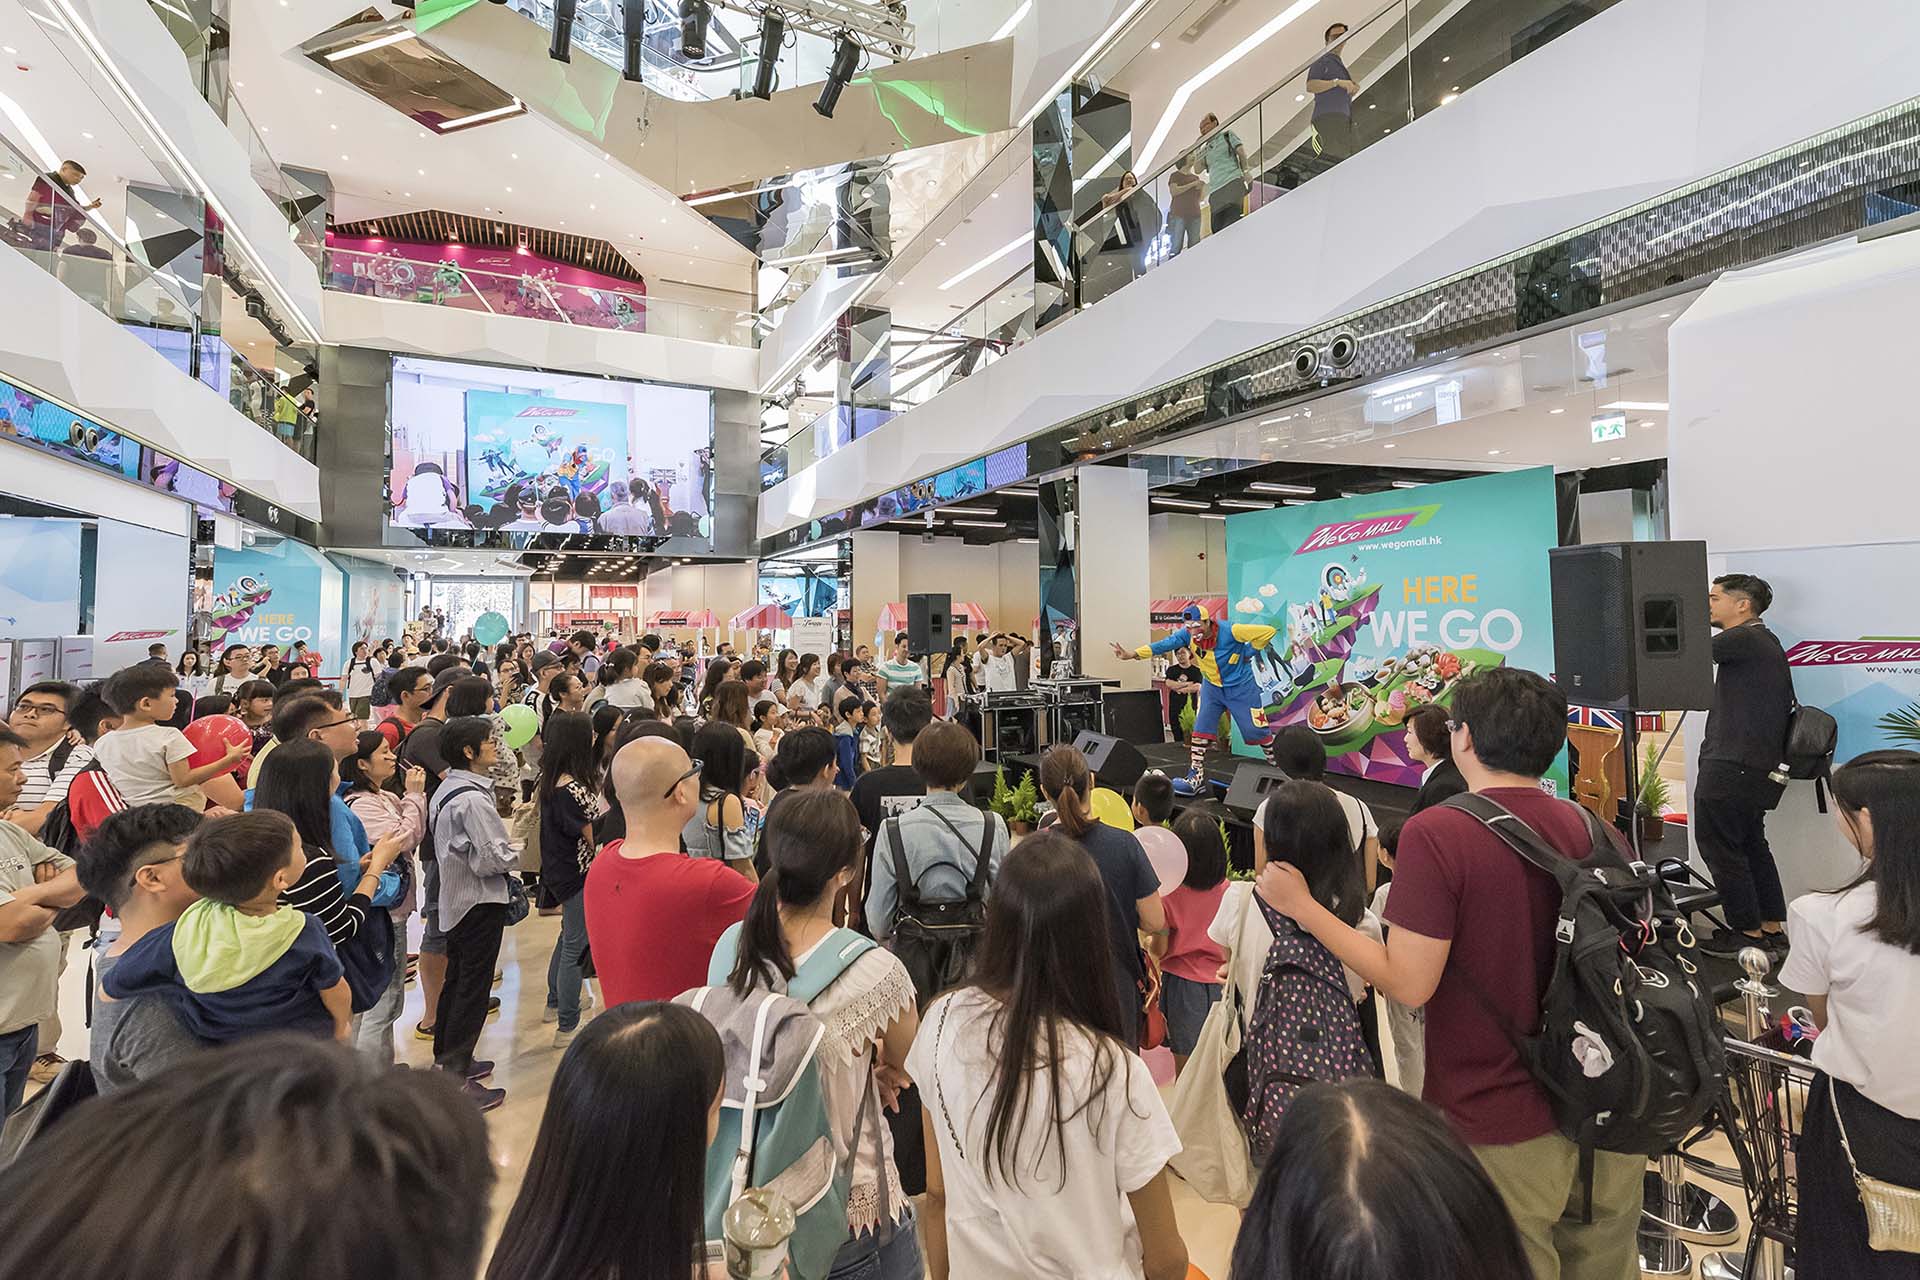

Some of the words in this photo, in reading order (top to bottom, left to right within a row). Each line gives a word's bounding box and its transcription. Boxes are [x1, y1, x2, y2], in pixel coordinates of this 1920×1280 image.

[1360, 519, 1404, 539] MALL
[1357, 535, 1442, 552] www.wegomall.hk
[1403, 573, 1479, 605] HERE
[259, 613, 295, 625] HERE
[239, 626, 270, 642] WE
[275, 625, 312, 642] GO
[1369, 611, 1428, 649] WE
[1439, 608, 1523, 651] GO
[1868, 647, 1920, 660] MAL
[1865, 666, 1920, 675] www.we
